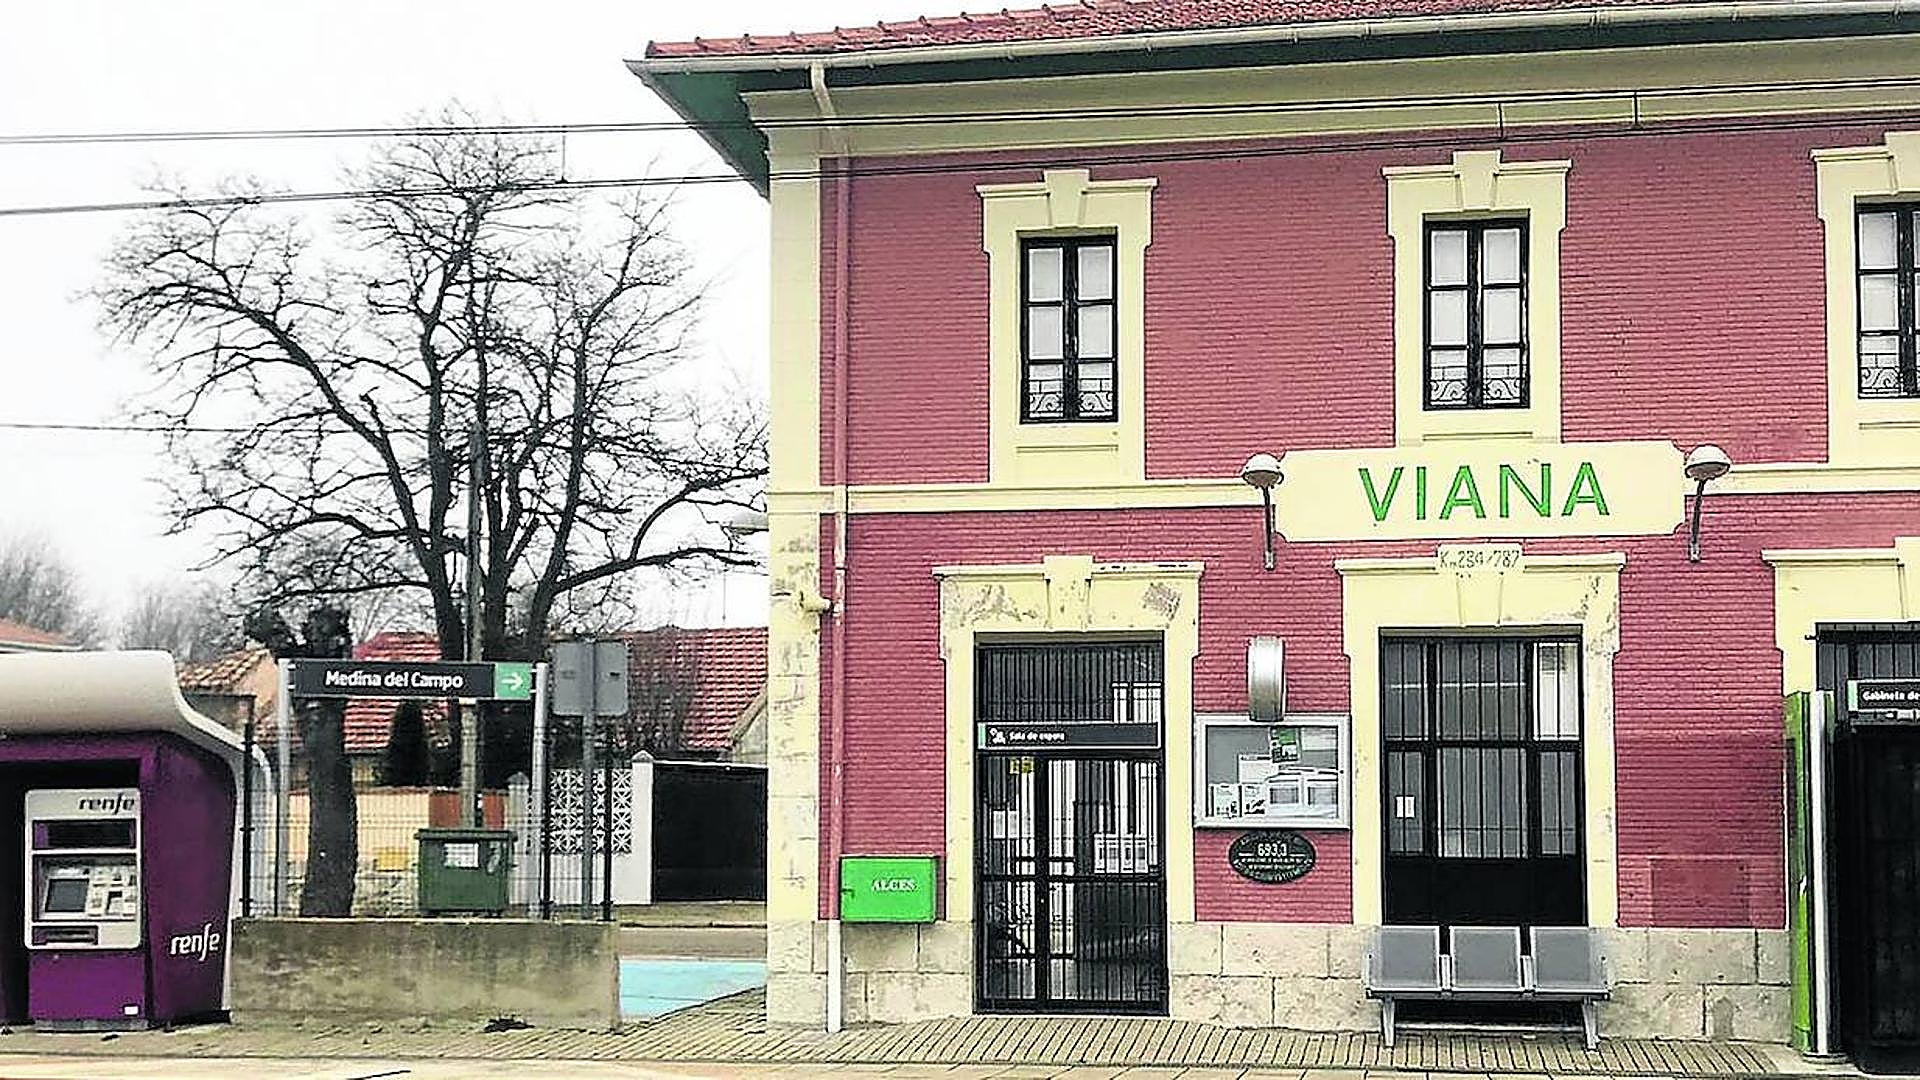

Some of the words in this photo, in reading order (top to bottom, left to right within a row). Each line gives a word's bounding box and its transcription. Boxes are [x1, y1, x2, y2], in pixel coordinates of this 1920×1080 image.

[1358, 462, 1610, 522] VIANA
[325, 670, 382, 687] Medina
[384, 672, 409, 688] del
[411, 672, 464, 691] Campo
[79, 792, 135, 816] renfe
[170, 923, 220, 962] renfe
